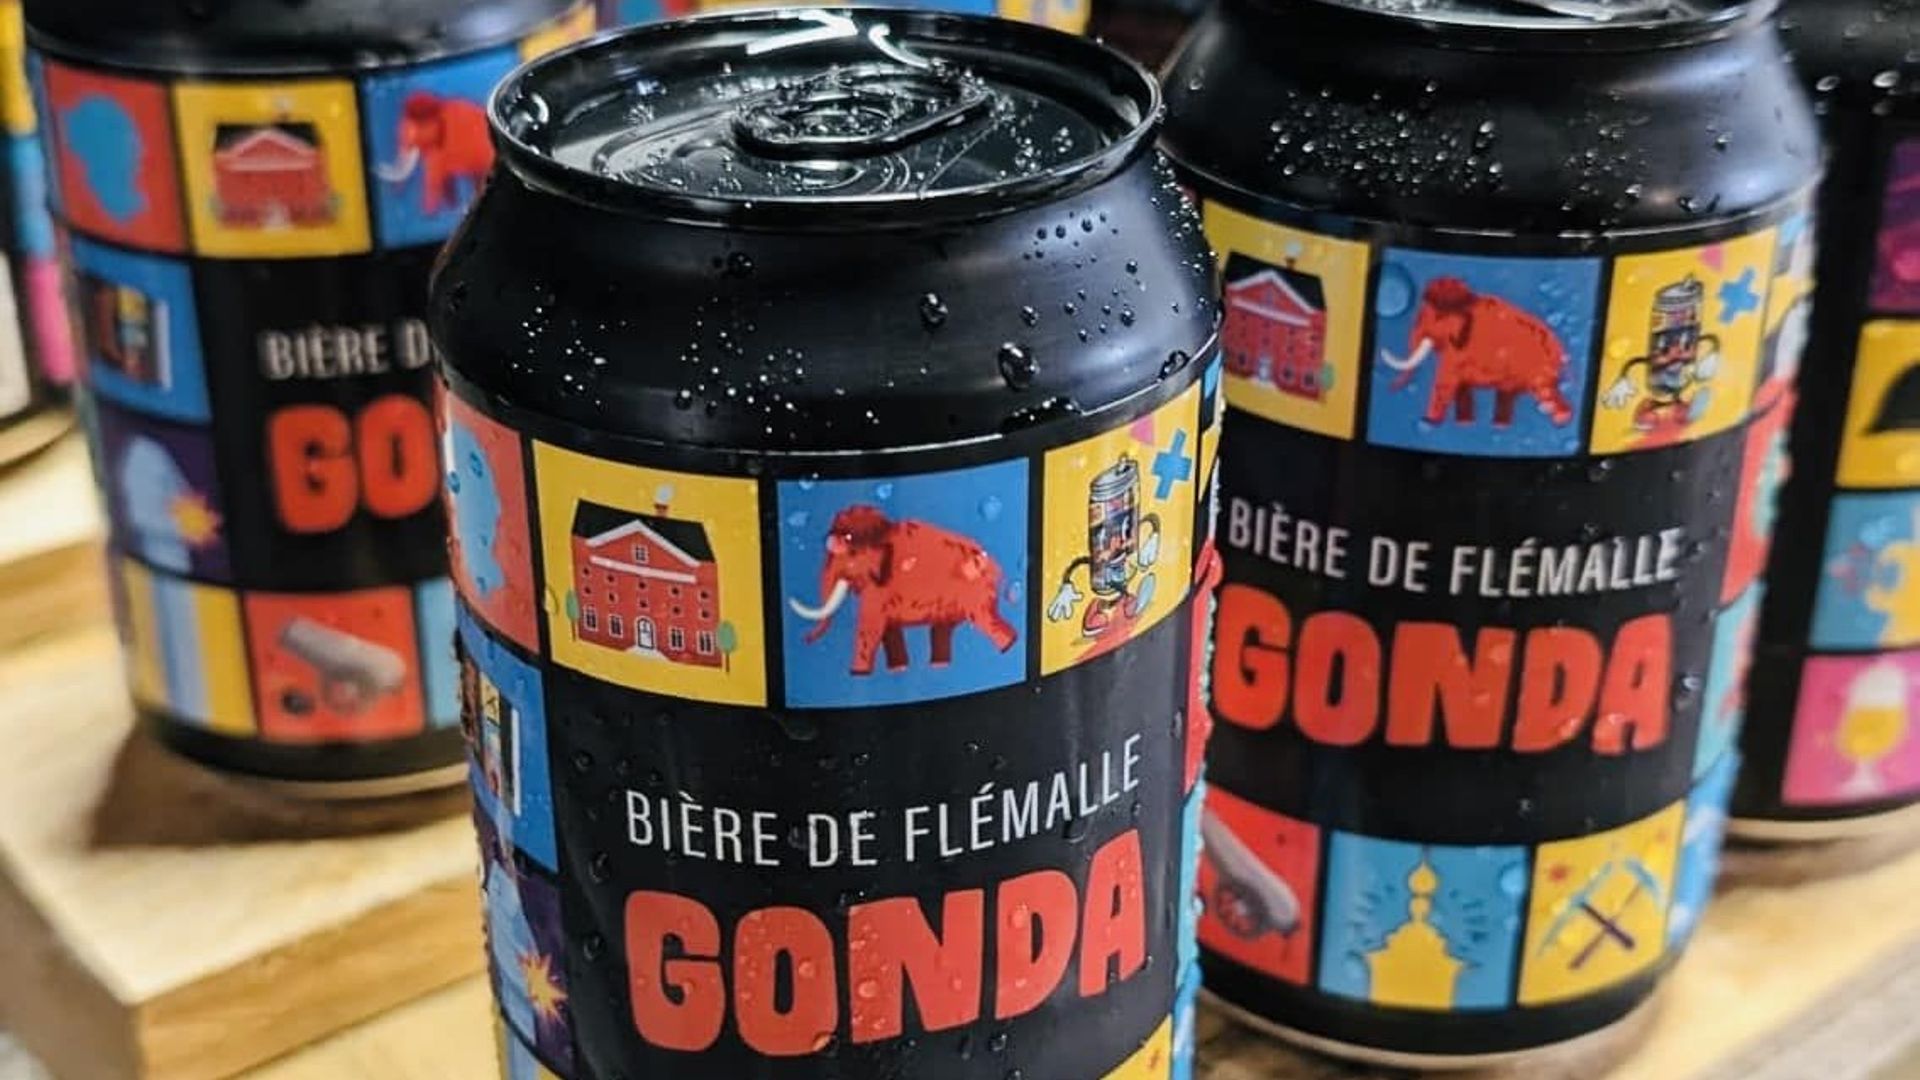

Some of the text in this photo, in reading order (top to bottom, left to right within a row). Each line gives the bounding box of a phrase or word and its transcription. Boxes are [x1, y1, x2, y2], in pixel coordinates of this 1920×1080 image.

[265, 323, 389, 379] BIÈRE
[1228, 497, 1685, 597] BIÈRE DE FLÉMALLE
[1212, 582, 1675, 756] GONDA
[626, 733, 1142, 868] BIÈRE DE FLÉMALLE
[624, 828, 1147, 1057] GONDA
